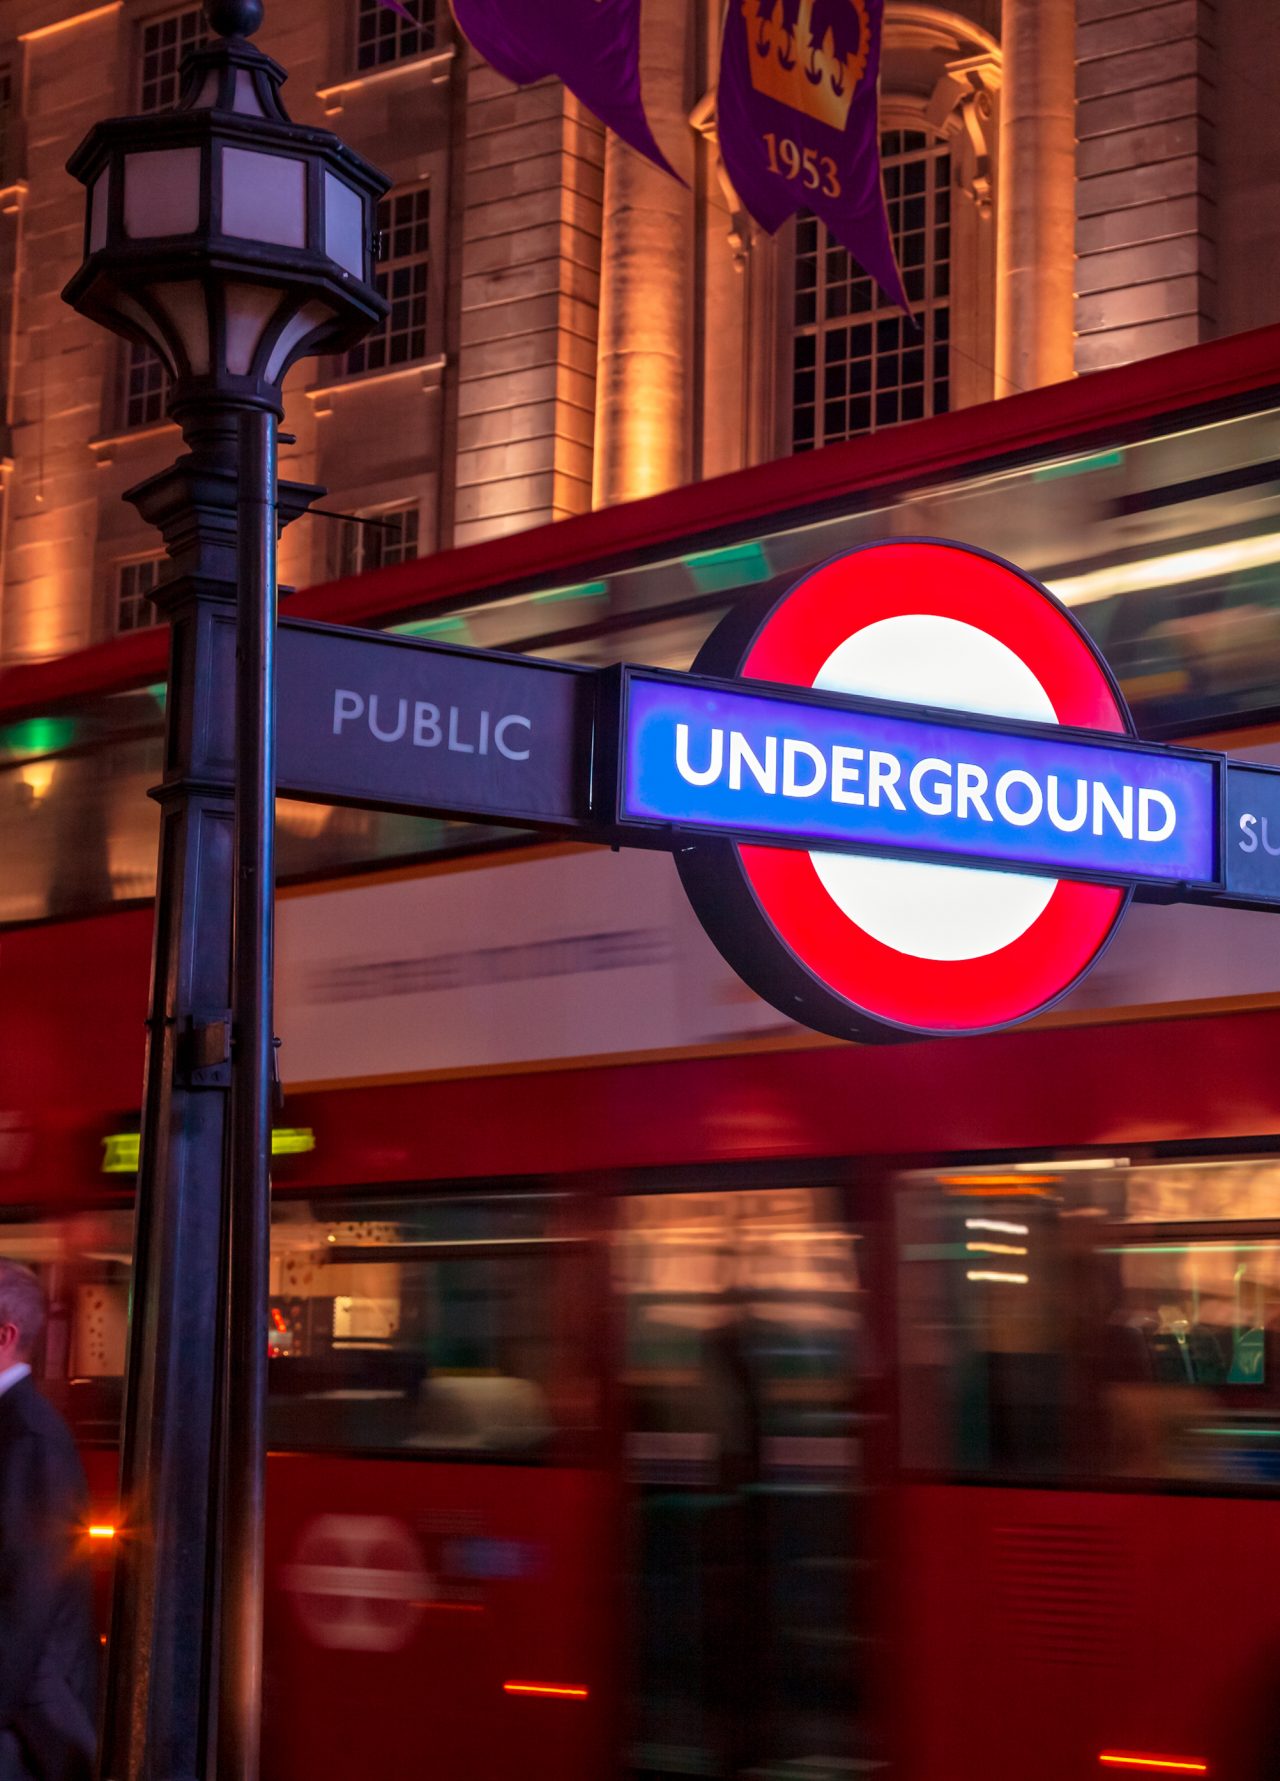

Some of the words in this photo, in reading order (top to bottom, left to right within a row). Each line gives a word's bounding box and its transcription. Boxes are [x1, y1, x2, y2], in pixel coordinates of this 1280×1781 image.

[763, 133, 841, 198] 1953
[332, 688, 532, 761] PUBLIC
[675, 724, 1177, 842] UNDERGROUND
